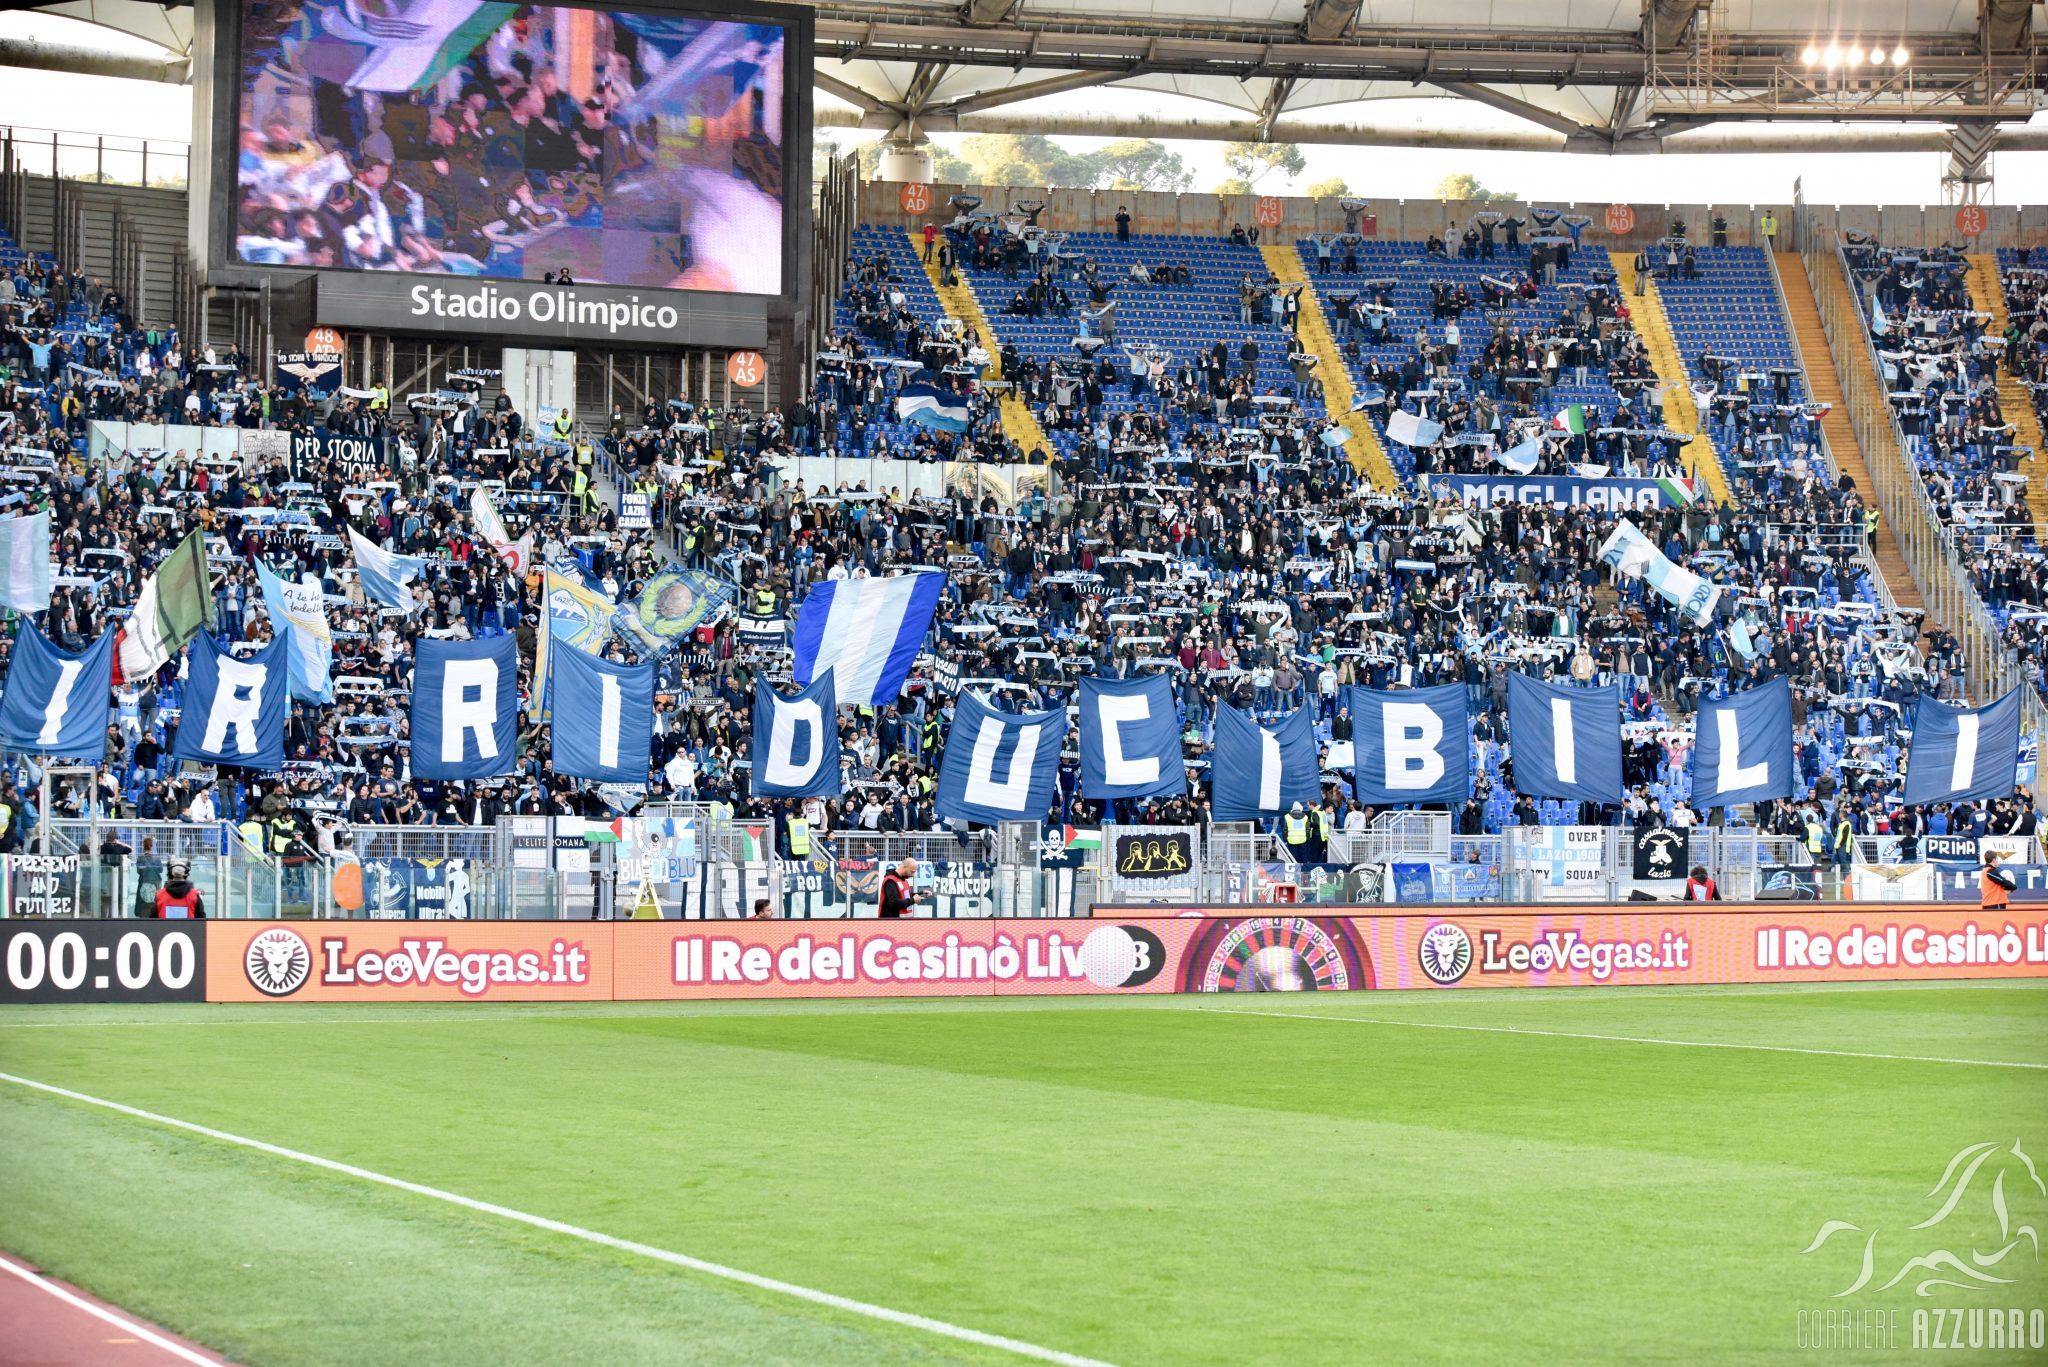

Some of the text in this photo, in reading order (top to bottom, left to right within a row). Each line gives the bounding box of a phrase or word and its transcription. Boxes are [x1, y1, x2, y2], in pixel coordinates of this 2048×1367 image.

[907, 184, 927, 198] 47
[906, 198, 926, 211] AD
[1258, 197, 1278, 210] 46
[1258, 211, 1278, 225] AS
[1610, 204, 1629, 218] 46
[1962, 206, 1980, 219] 45
[1609, 218, 1630, 231] AD
[1961, 219, 1980, 232] AS
[411, 284, 678, 332] Stadio Olimpico
[314, 327, 334, 342] 48
[736, 352, 756, 367] 47
[735, 367, 756, 382] AS
[295, 437, 376, 463] PER STORIA
[622, 493, 647, 505] FORZA
[1463, 484, 1659, 514] MAGLIANA
[622, 505, 646, 516] LAZIO
[618, 516, 651, 528] CARICA
[518, 838, 546, 847] L'ELITE
[1568, 831, 1598, 842] OVER
[1992, 841, 2016, 850] VILLA
[1539, 848, 1573, 860] LAZIO
[1575, 848, 1601, 861] 1900
[11, 854, 77, 873] PRESENT
[1647, 867, 1672, 879] lazio
[1757, 928, 1778, 967] Il
[1786, 928, 1832, 967] Re
[1835, 926, 1897, 966] del
[1902, 923, 2021, 966] Casinò
[6, 931, 196, 990] 00:00
[675, 934, 1088, 983] Il Re del Casinò Liv
[1482, 932, 1689, 978] LeoVegas.it
[324, 938, 587, 991] LeoVegas.it
